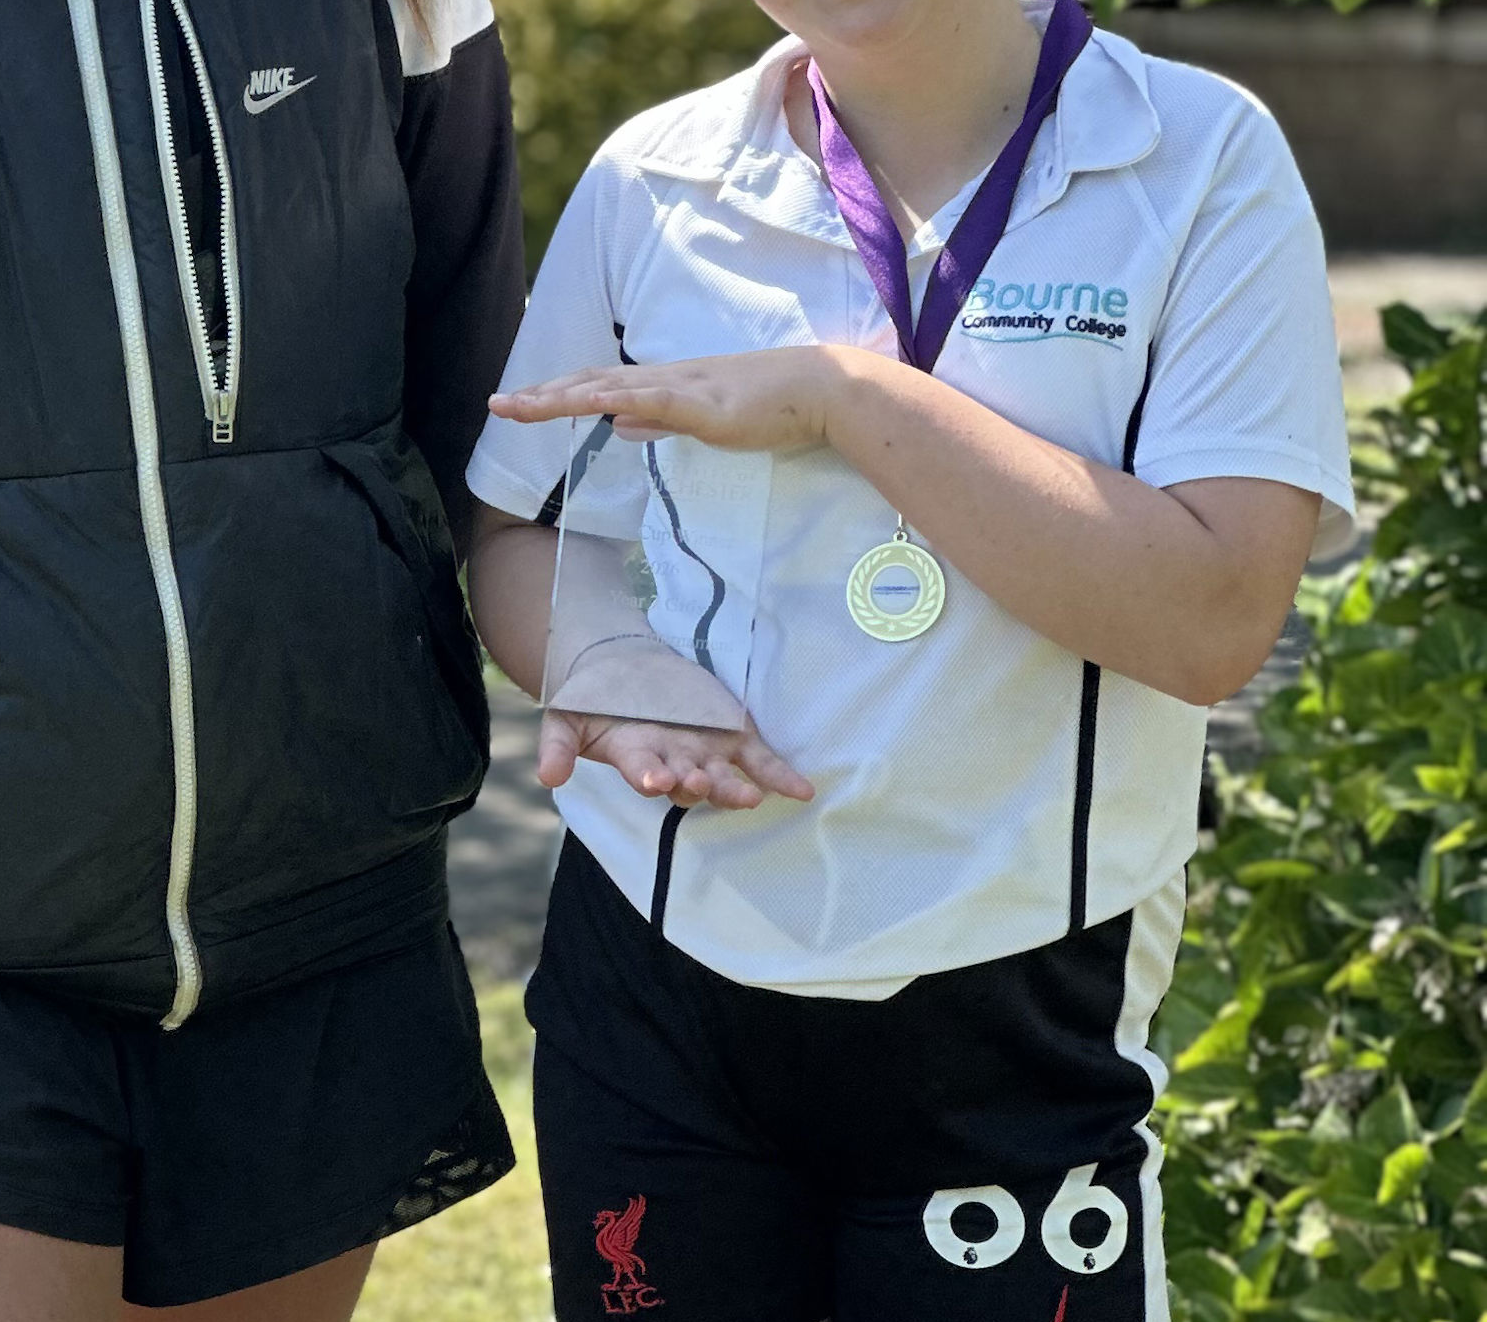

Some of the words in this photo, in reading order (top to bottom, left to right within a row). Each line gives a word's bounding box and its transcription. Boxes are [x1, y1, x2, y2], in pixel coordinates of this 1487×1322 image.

[249, 67, 295, 95] NIKE
[966, 278, 1128, 318] Bourne
[962, 312, 1055, 334] Community
[1065, 315, 1127, 340] College
